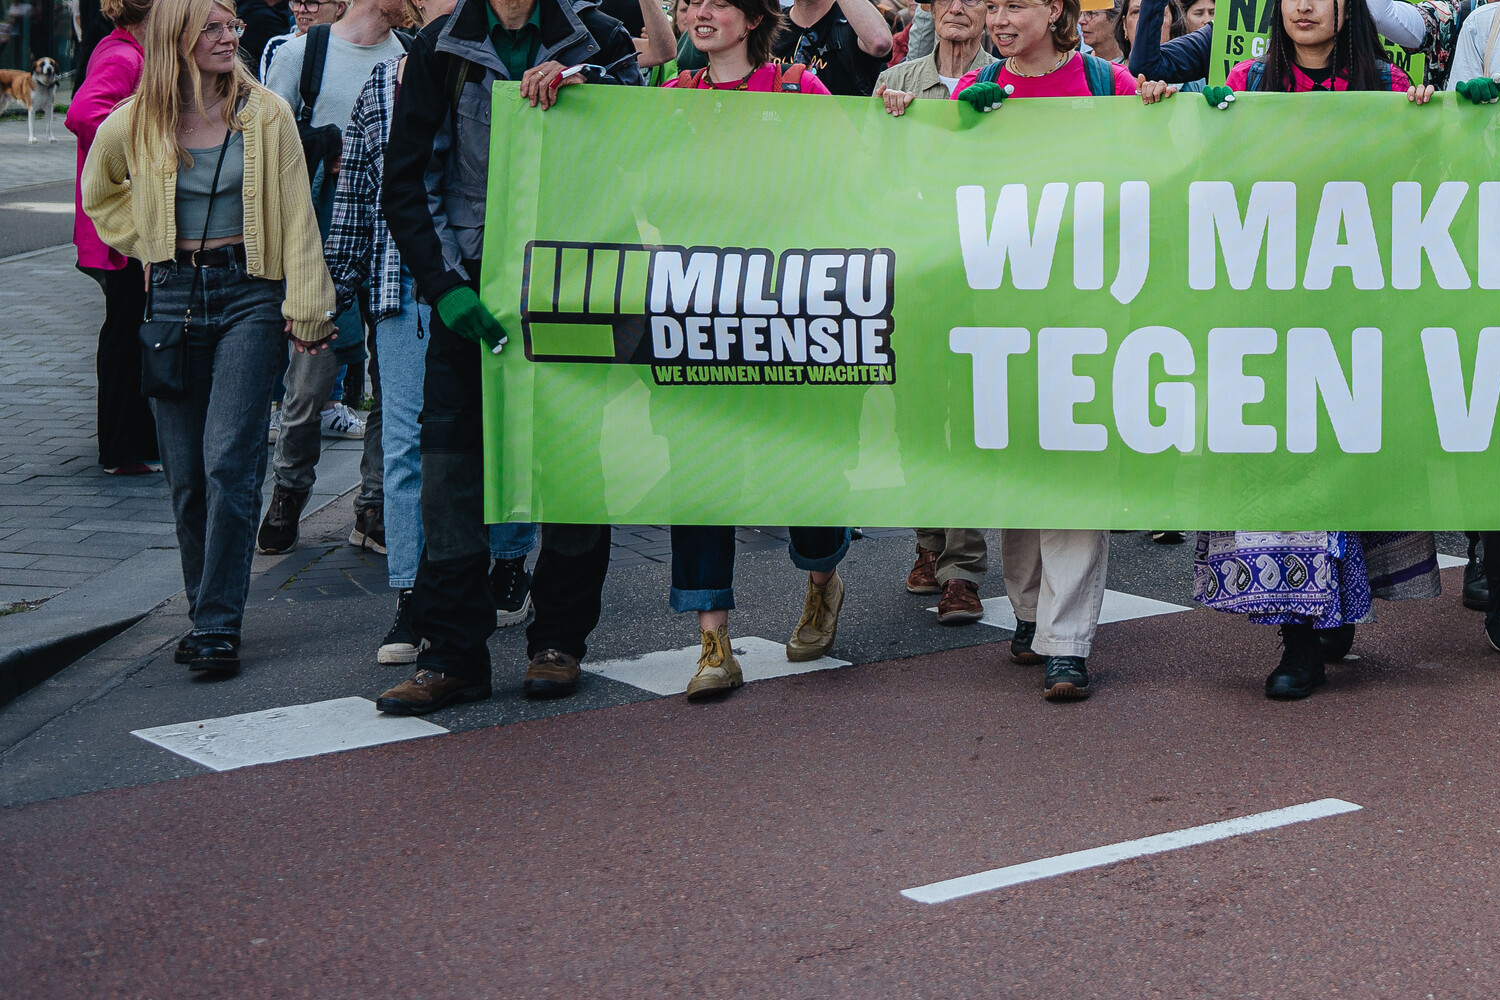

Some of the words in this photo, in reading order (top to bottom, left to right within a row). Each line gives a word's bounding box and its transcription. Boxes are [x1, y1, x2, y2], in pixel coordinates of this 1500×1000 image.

[1225, 34, 1245, 56] IS
[956, 180, 1150, 304] WIJ
[650, 251, 888, 316] MILIEU
[651, 315, 888, 364] DEFENSIE
[655, 366, 683, 382] WE
[686, 366, 760, 382] KUNNEN
[763, 366, 804, 382] NIET
[806, 365, 892, 382] WACHTEN
[949, 325, 1382, 453] TEGEN
